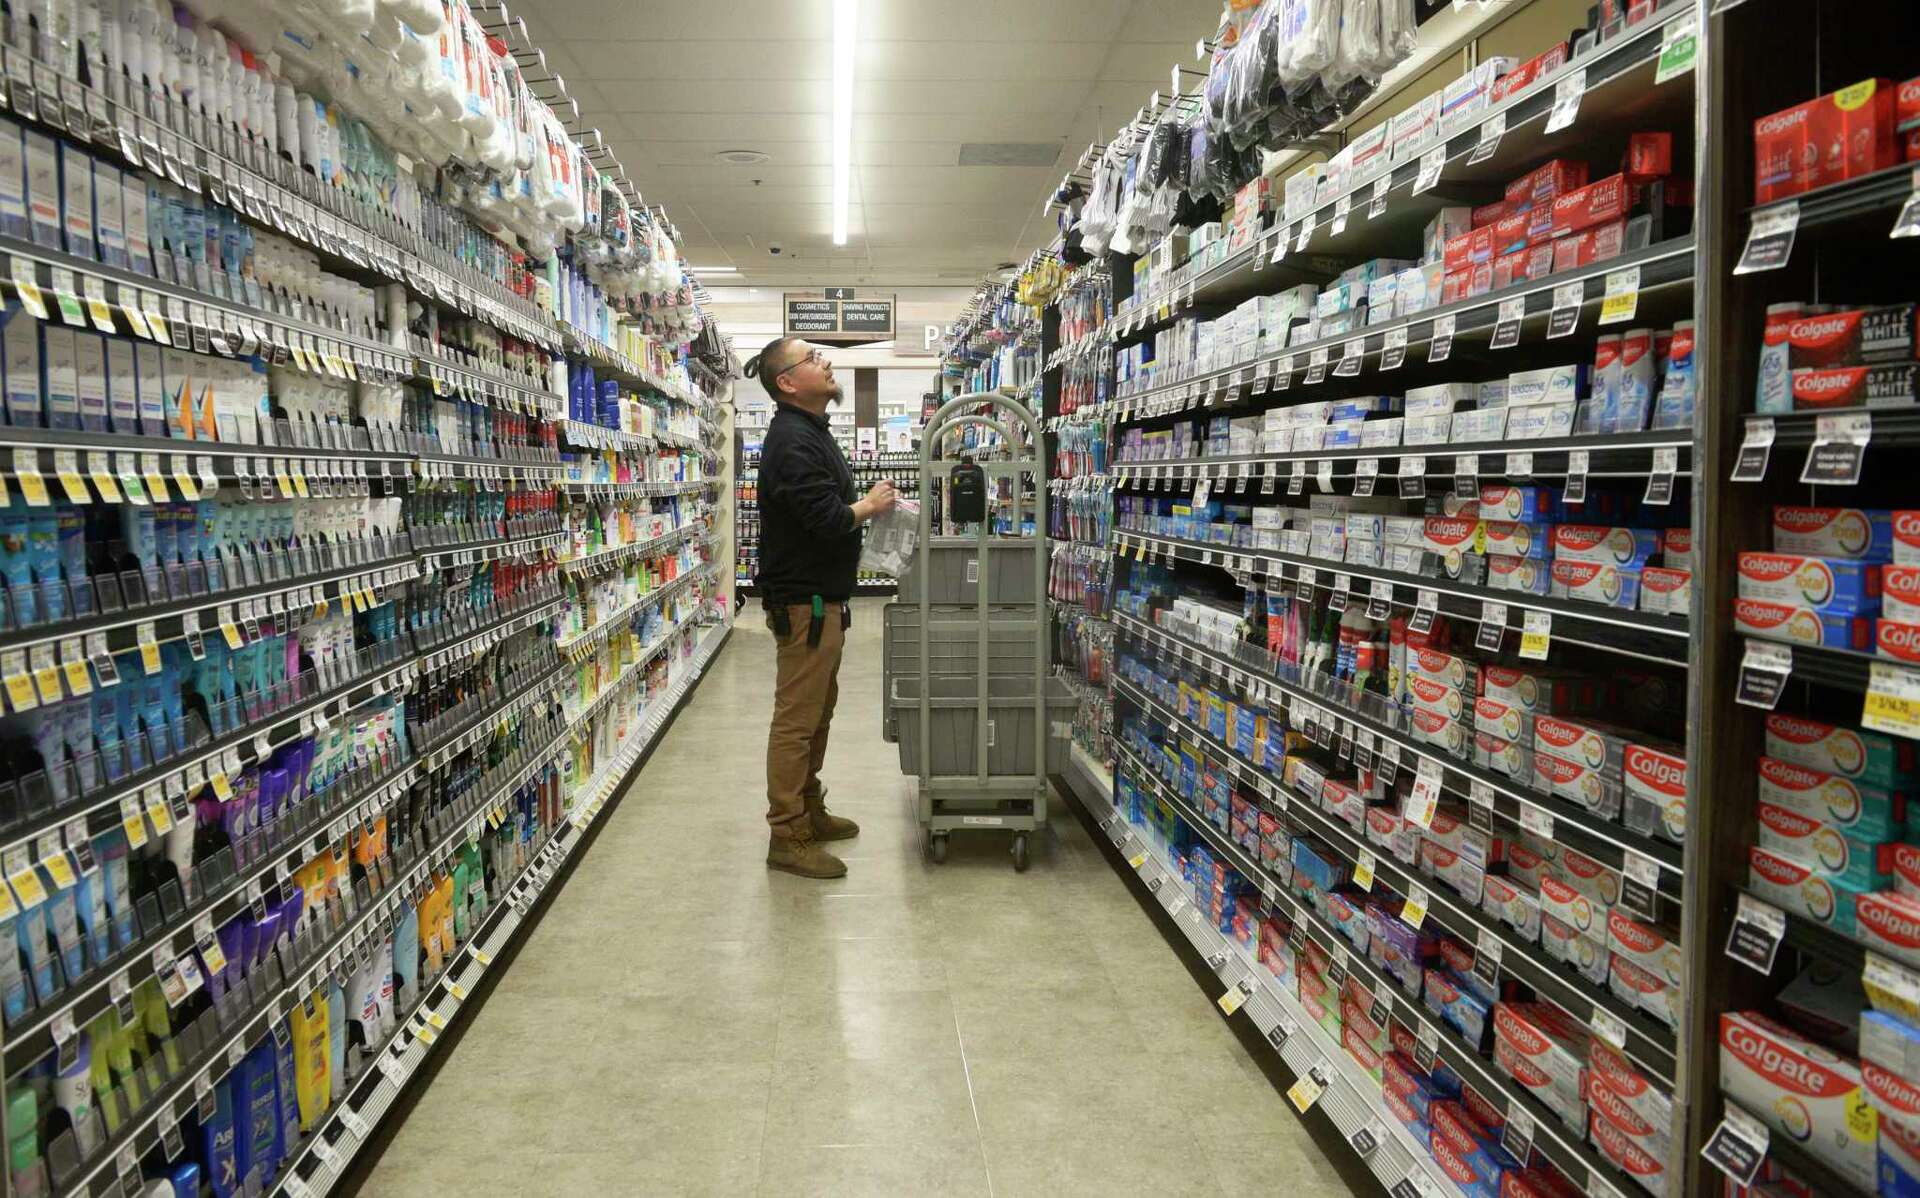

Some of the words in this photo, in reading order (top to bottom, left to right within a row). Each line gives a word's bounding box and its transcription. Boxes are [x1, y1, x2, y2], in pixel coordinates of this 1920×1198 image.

[1757, 110, 1809, 135] Colgate
[1555, 191, 1586, 210] Colgate
[1592, 190, 1618, 206] WHITE
[836, 288, 843, 299] 4
[796, 303, 830, 311] COSMETICS
[843, 303, 863, 311] SHAVING
[863, 303, 890, 311] PRODUCTS
[1789, 318, 1847, 340] Colgate
[1861, 323, 1909, 341] WHITE
[1794, 374, 1851, 392] Colgate
[1867, 380, 1913, 396] WHITE
[1774, 507, 1829, 525] Colgate
[1426, 518, 1468, 537] Colgate
[1557, 526, 1601, 544] Colgate
[1553, 562, 1593, 579] Colgate
[1739, 555, 1793, 573] Colgate
[1735, 601, 1785, 622] Colgate
[1537, 719, 1576, 741] Colgate
[1766, 715, 1824, 738] Colgate
[1536, 756, 1575, 778] Colgate
[1760, 759, 1819, 786] Colgate
[1760, 806, 1810, 833] Colgate
[1752, 852, 1800, 880] Colgate
[1610, 915, 1656, 950] Colgate
[1497, 1006, 1541, 1051] Colgate
[1591, 1042, 1637, 1093] Colgate
[1726, 1025, 1828, 1093] Colgate
[1384, 1057, 1414, 1092] Colgate
[1384, 1084, 1413, 1121] Colgate
[1591, 1079, 1645, 1130] Colgate
[1435, 1105, 1471, 1151] Colgate
[1594, 1117, 1650, 1169] Colgate
[1432, 1135, 1471, 1182] Colgate
